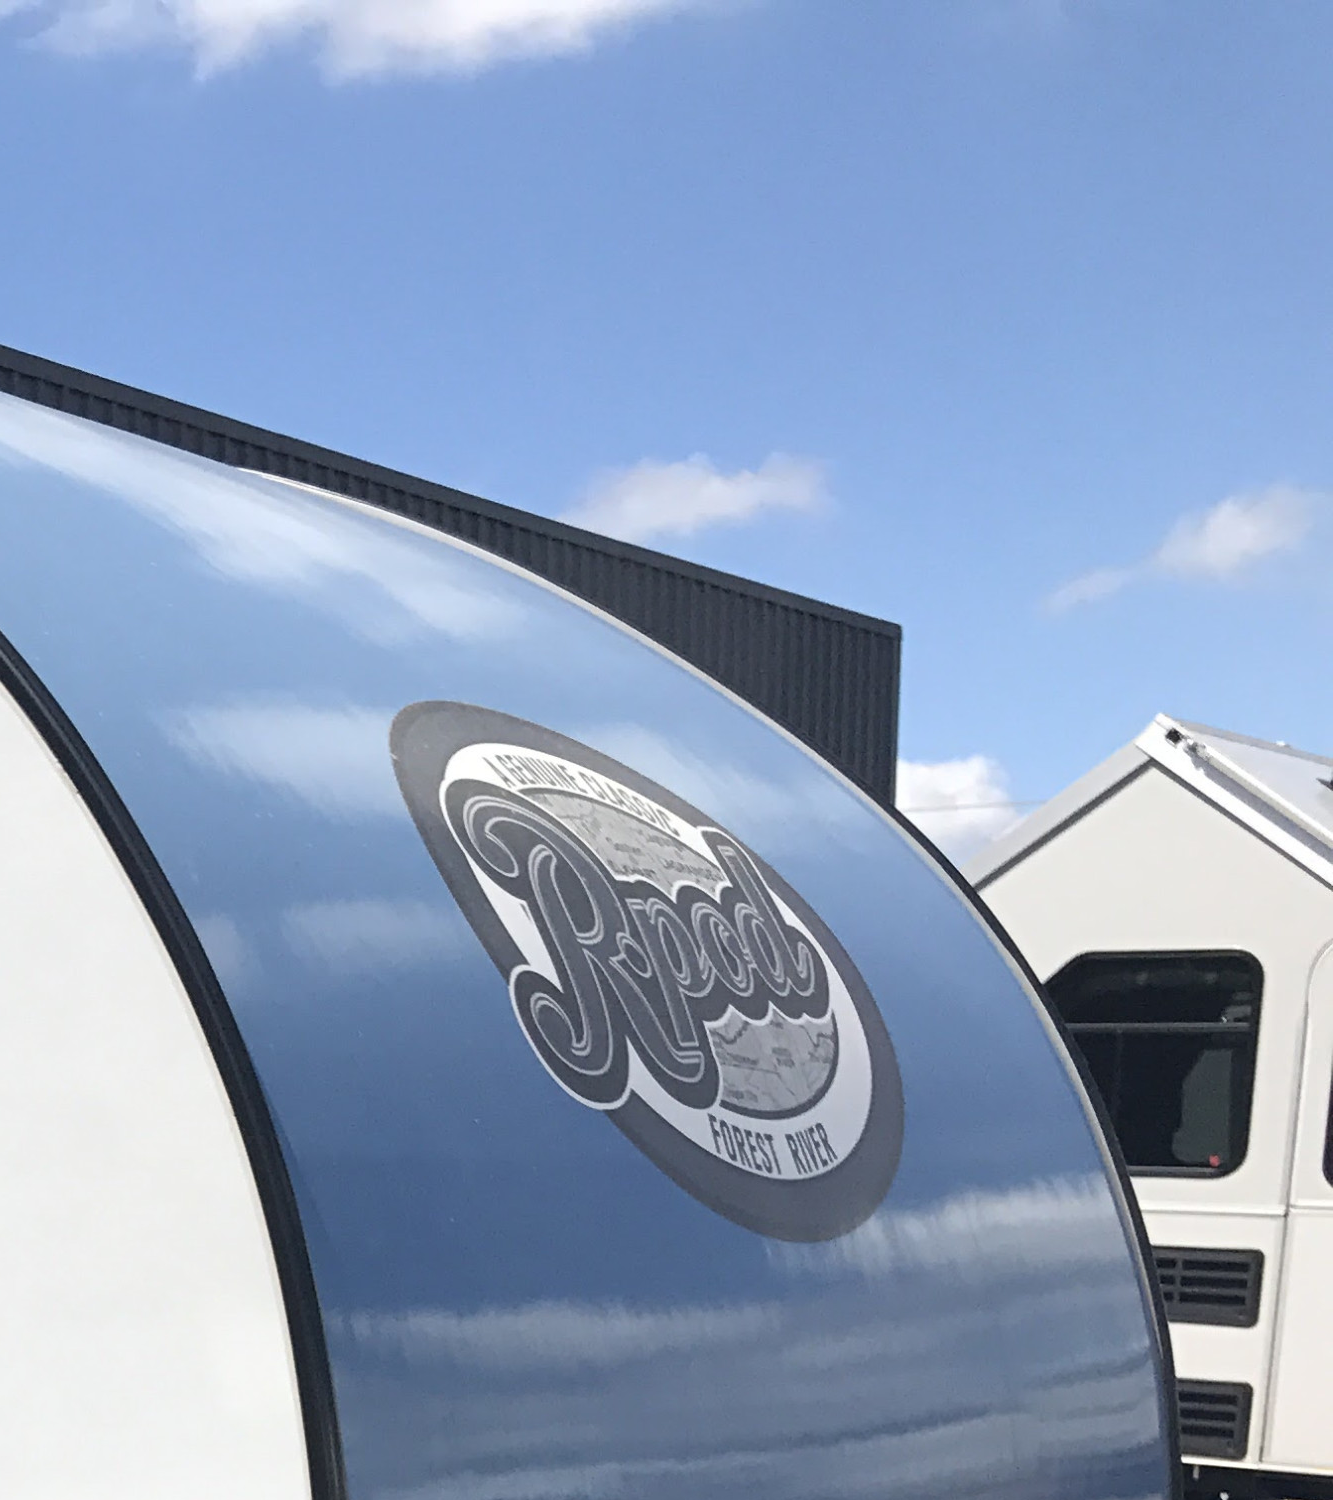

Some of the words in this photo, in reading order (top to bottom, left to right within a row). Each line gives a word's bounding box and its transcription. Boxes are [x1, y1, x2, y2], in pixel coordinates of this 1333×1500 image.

[482, 756, 517, 788] A
[494, 754, 588, 794] GENUINE
[578, 771, 681, 837] CLASSIC
[706, 1113, 782, 1176] FOREST
[786, 1122, 838, 1176] RIVER
